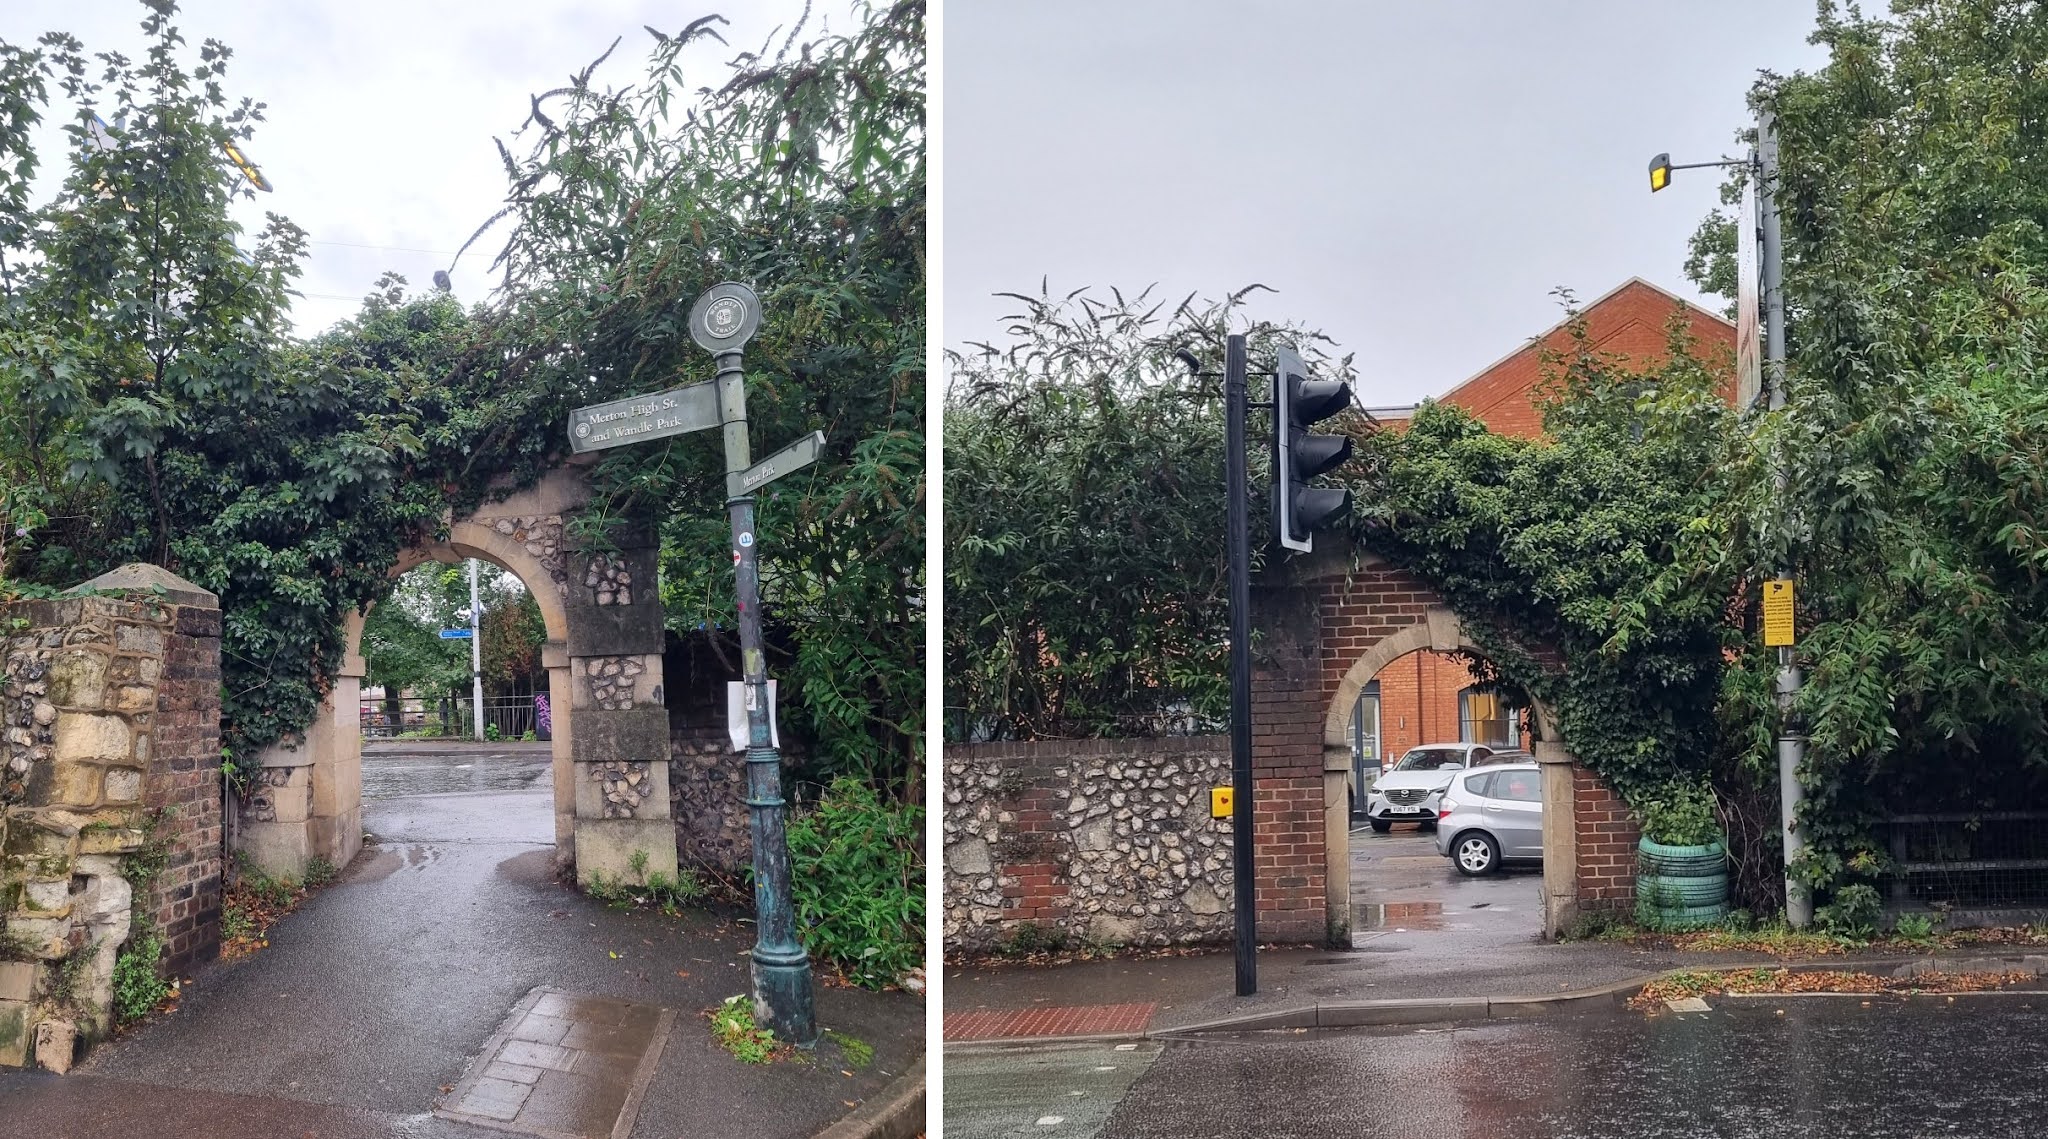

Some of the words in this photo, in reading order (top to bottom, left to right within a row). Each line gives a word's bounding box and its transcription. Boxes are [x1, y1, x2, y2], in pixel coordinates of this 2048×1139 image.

[709, 301, 738, 315] WANDLE
[715, 324, 737, 334] TRAIL
[589, 411, 627, 425] Merton
[630, 402, 659, 417] High
[662, 398, 678, 410] St.
[591, 429, 610, 443] and
[613, 421, 653, 438] Wandle
[657, 416, 682, 430] Park
[743, 473, 761, 489] Merton
[762, 462, 775, 479] Park
